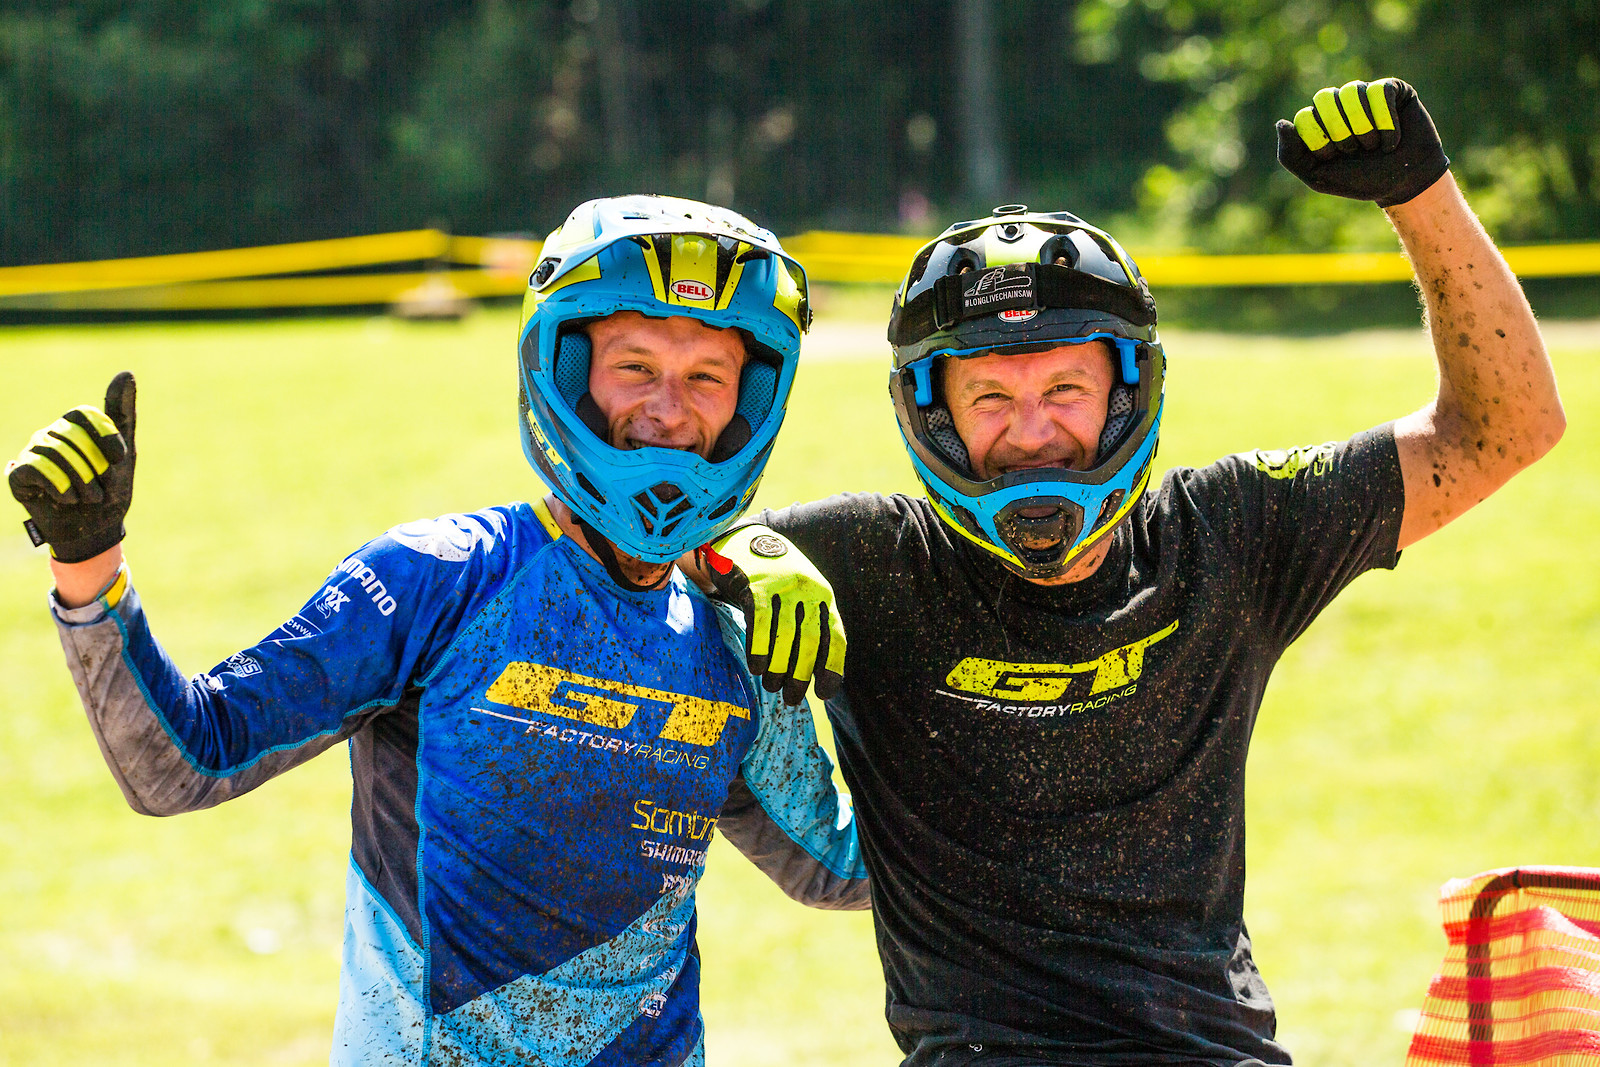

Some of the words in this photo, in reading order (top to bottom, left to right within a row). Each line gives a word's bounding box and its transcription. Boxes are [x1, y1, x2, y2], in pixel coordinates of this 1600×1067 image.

[677, 284, 709, 297] BELL
[964, 290, 1033, 308] #LONGLIVECHAINSAW
[1004, 309, 1032, 318] BELL
[945, 619, 1180, 701] GT
[485, 661, 751, 747] GT
